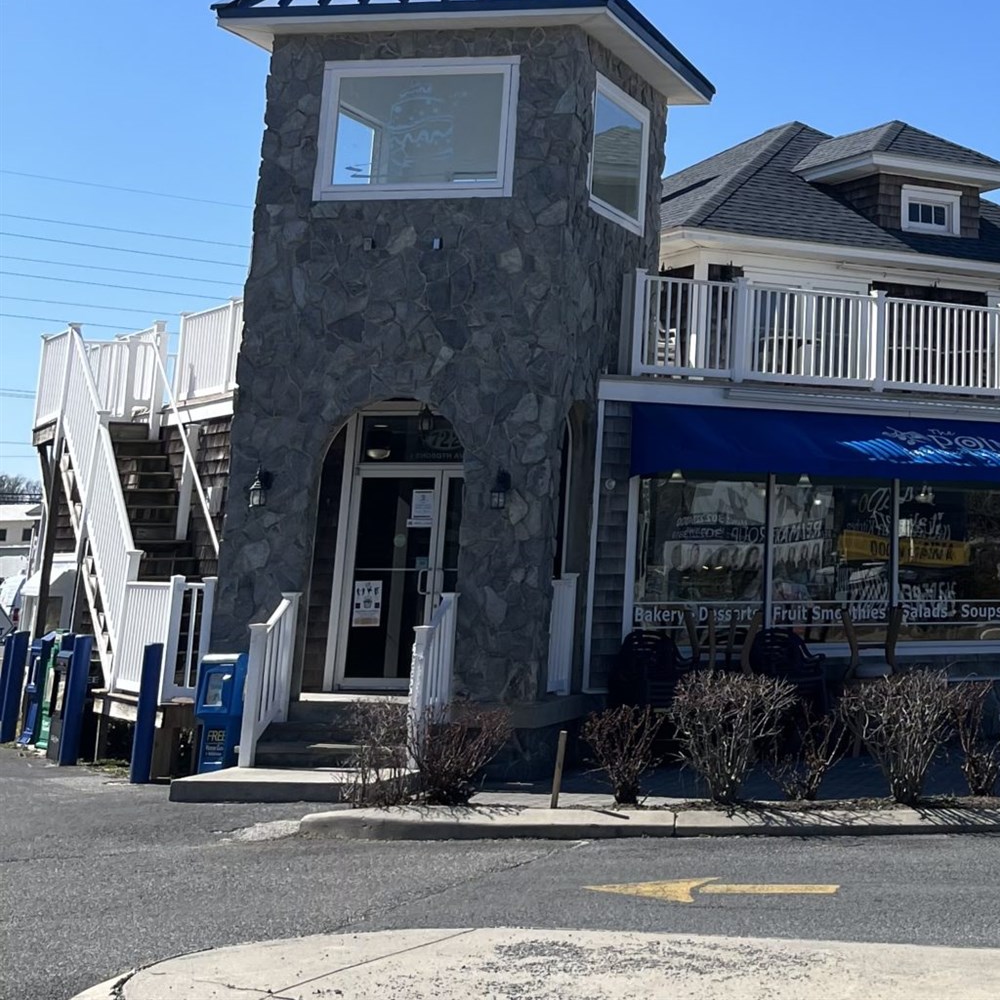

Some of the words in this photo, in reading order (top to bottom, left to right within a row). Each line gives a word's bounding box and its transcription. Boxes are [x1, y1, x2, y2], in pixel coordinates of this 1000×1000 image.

[634, 606, 684, 625] Bakery
[773, 605, 807, 621] Fruit
[812, 605, 887, 621] Smothies
[902, 603, 948, 619] Salads
